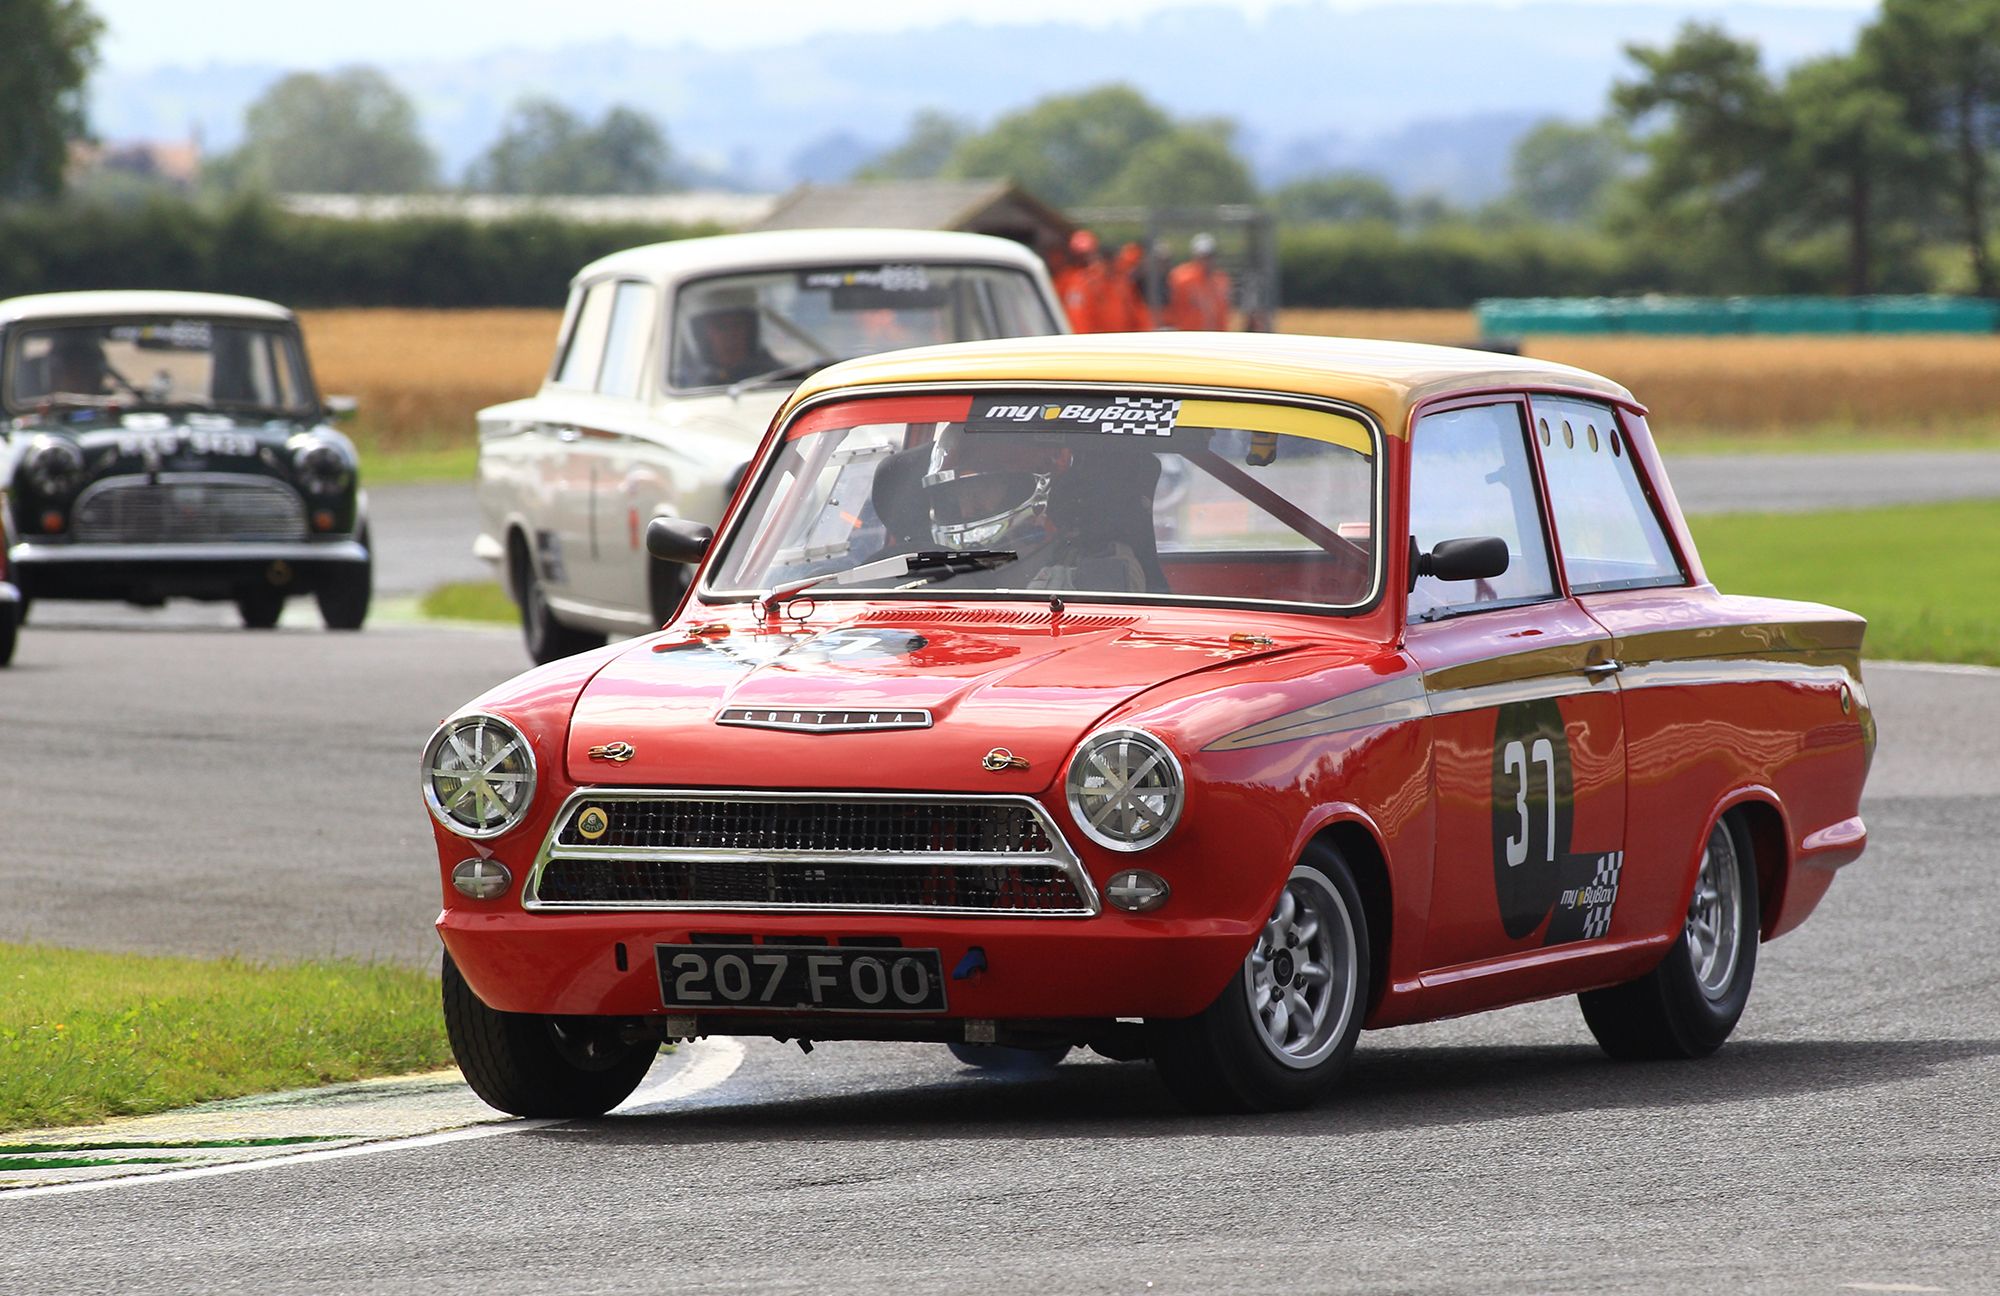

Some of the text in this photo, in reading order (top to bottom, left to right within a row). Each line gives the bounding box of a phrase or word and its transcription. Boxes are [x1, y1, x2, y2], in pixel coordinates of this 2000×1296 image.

[744, 711, 902, 724] CORTINA
[672, 953, 929, 1004] 207 FOO
